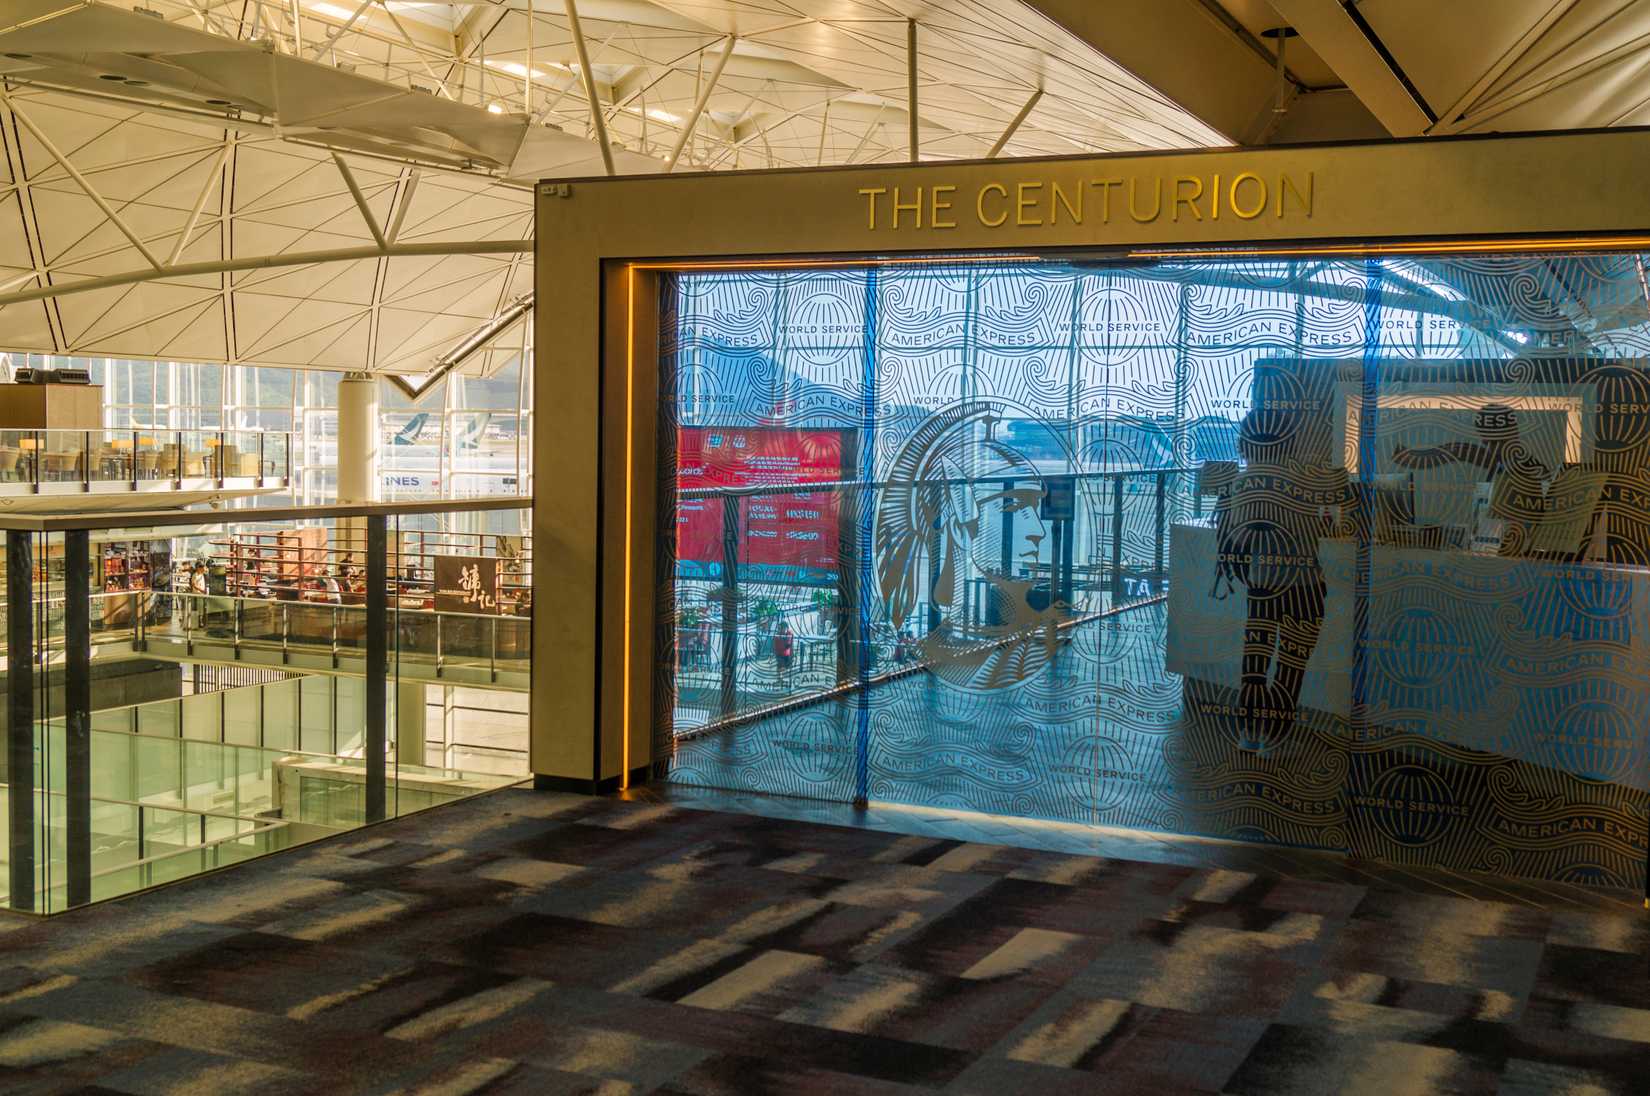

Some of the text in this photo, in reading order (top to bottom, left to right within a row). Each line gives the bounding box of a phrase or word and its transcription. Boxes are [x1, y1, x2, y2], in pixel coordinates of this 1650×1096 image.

[858, 171, 1314, 230] THE CENTURION
[778, 325, 869, 334] WORLD SERVICE
[1058, 323, 1161, 332] WORLD SERVICE
[1187, 322, 1352, 345] AMERICAN EXPRESS
[1373, 320, 1423, 329] WORLD
[701, 327, 758, 347] EXPRESS
[891, 324, 1036, 346] AMERICAN EXPRESS
[692, 394, 735, 404] SERVICE
[755, 396, 892, 416] AMERICAN EXPRESS
[914, 396, 954, 405] WORLD
[1211, 399, 1321, 410] WORLD SERVICE
[1031, 399, 1185, 421] AMERICAN EXPRESS
[1272, 478, 1345, 504] EXPRESS
[1513, 486, 1612, 511] AMERICAN
[1219, 553, 1314, 567] ORLD SERVICE
[1099, 622, 1151, 634] SERVICE
[1024, 694, 1175, 722] AMERICAN EXPRESS
[1200, 704, 1309, 721] WORLD SERVICE
[772, 739, 810, 751] WORLD
[882, 755, 1025, 781] AMERICAN EXPRESS
[1051, 765, 1147, 782] WORLD SERVICE
[1263, 786, 1336, 814] EXPRESS
[1353, 796, 1469, 817] WORLD SERVICE
[1500, 818, 1596, 838] AMERICAN
